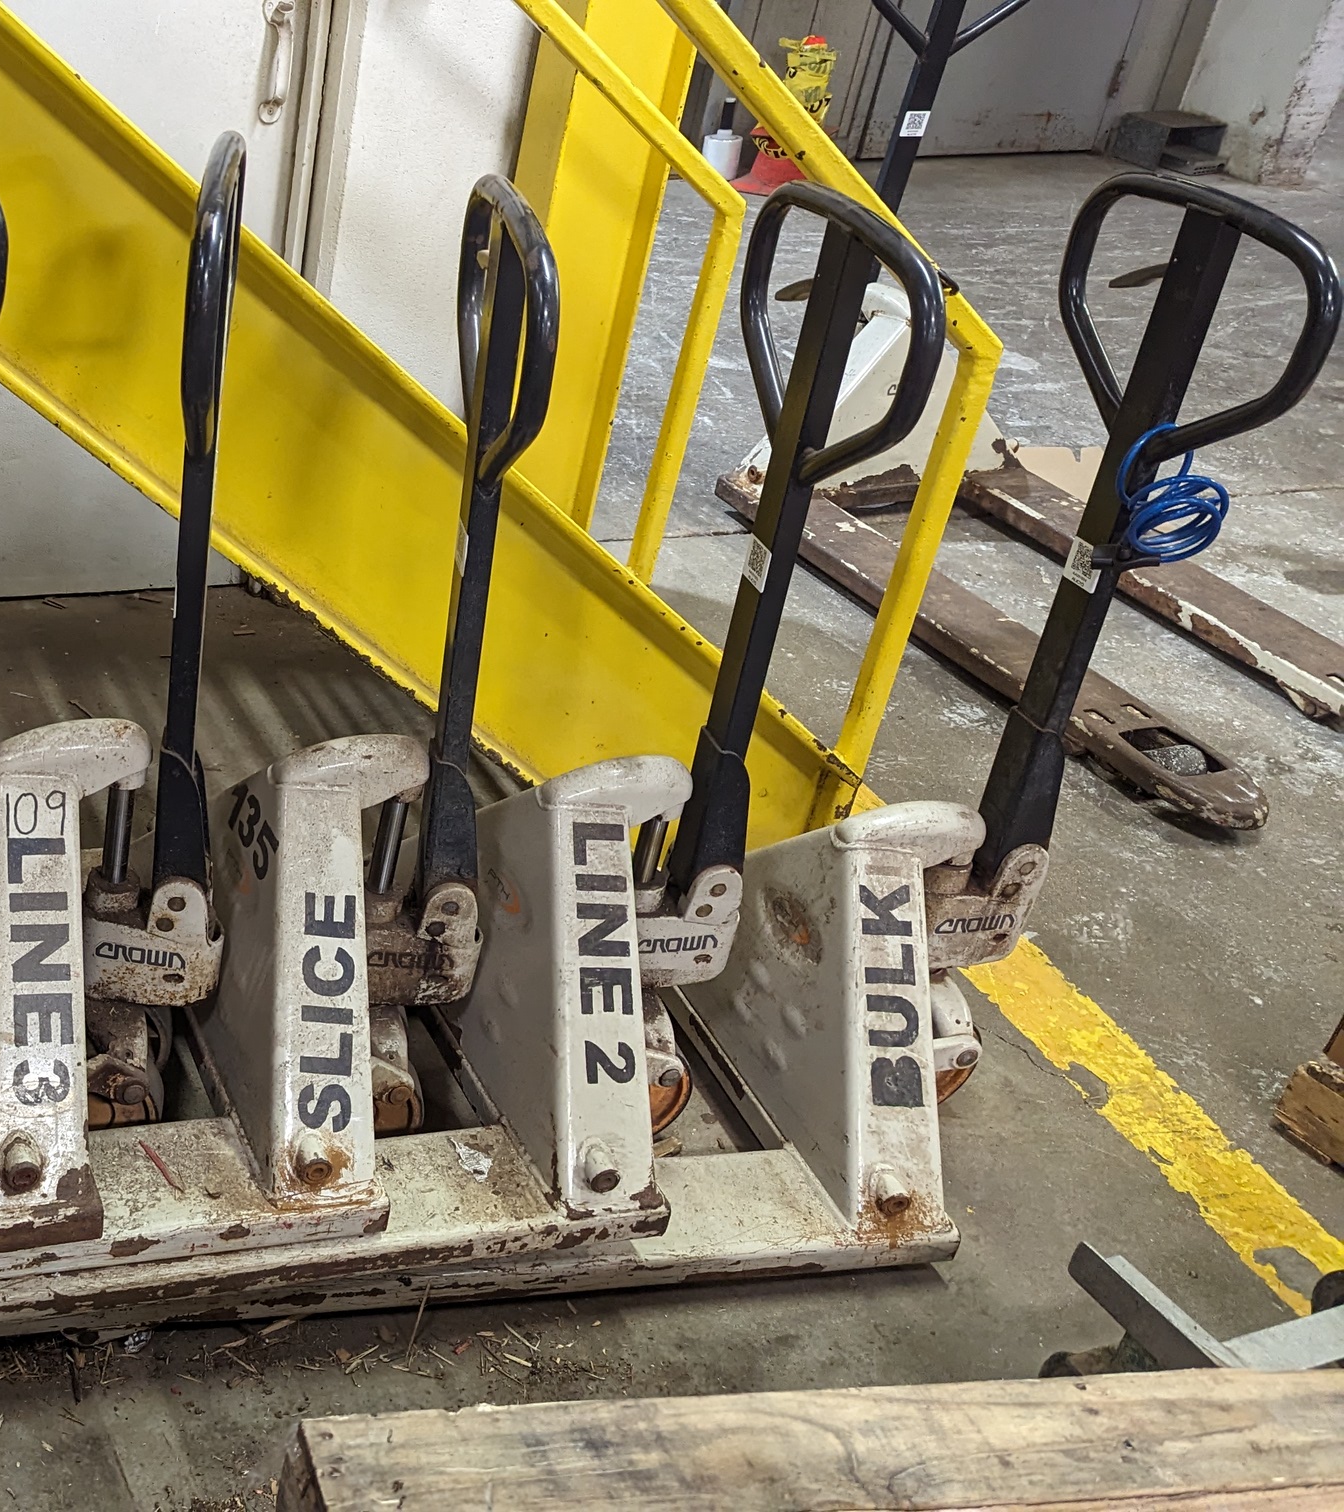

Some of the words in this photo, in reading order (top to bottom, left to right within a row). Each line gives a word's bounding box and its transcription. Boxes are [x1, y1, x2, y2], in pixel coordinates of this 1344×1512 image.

[6, 789, 66, 837] 109
[228, 782, 280, 880] 135
[572, 821, 634, 1016] LINE
[934, 914, 1016, 935] CROWN
[94, 941, 187, 971] CROWN
[637, 934, 719, 954] CROWN
[297, 891, 357, 1134] SLICE
[859, 883, 926, 1109] BULK
[584, 1039, 636, 1085] 2
